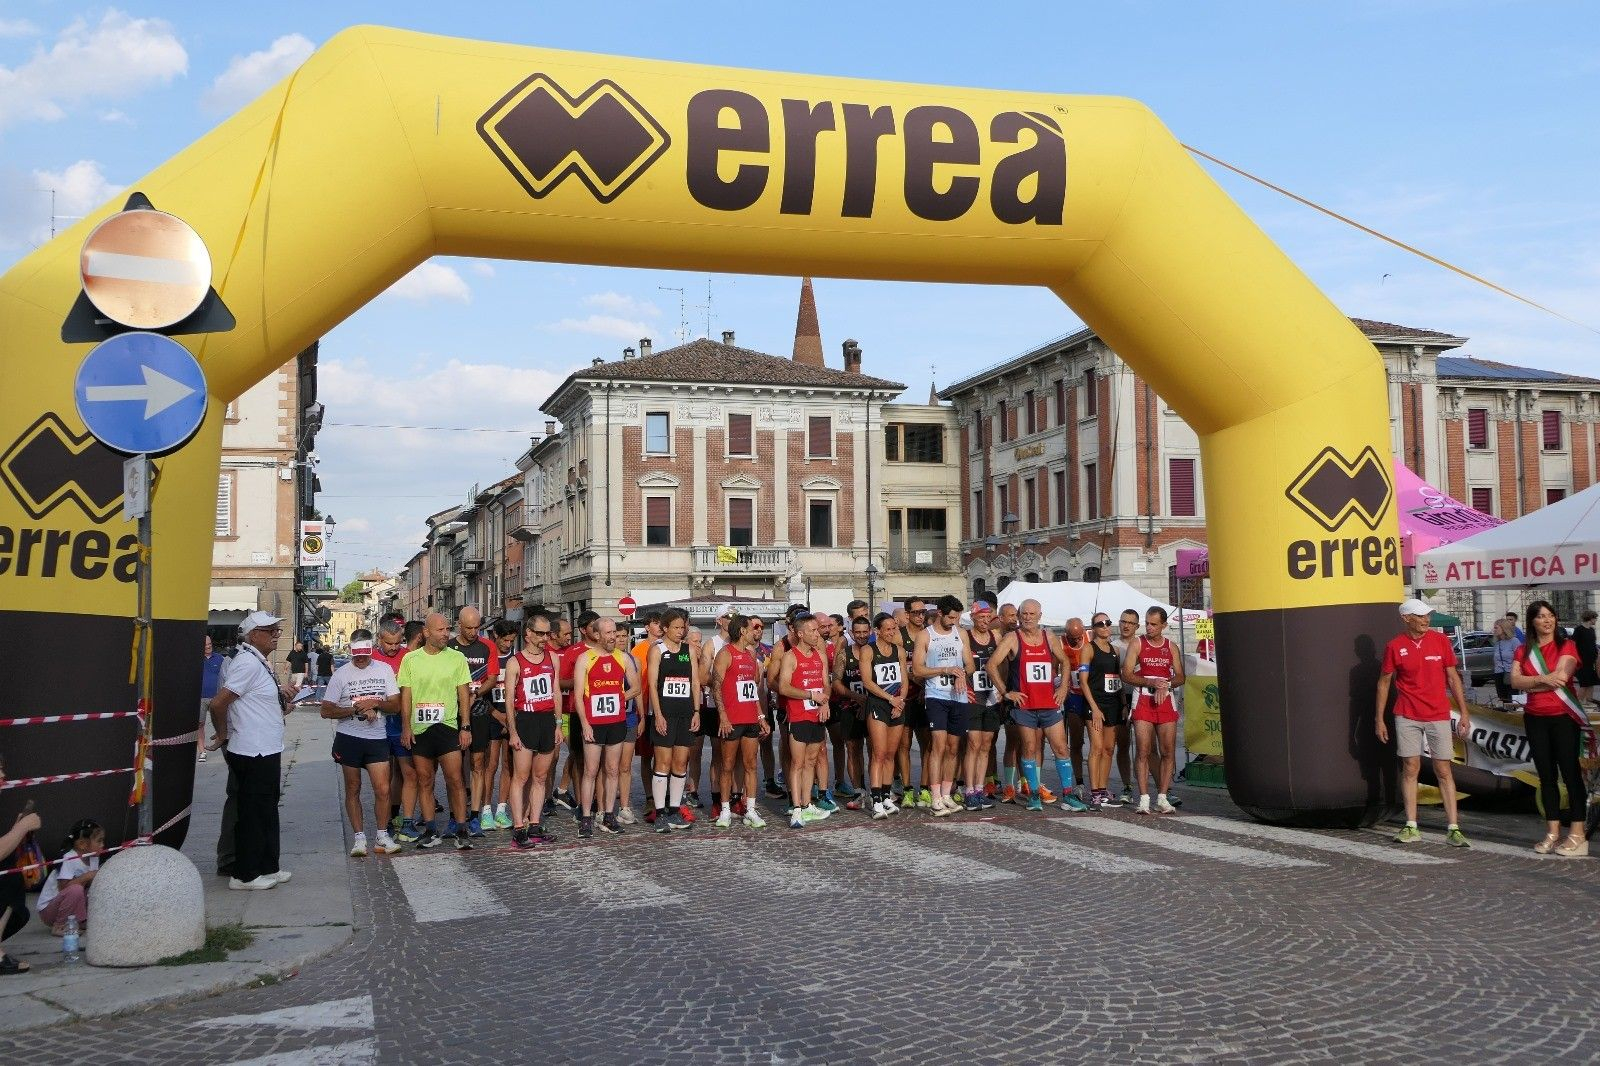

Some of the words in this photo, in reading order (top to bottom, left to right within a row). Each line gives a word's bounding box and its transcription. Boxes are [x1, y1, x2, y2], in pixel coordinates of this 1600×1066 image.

[1445, 555, 1566, 581] ATLETICA
[1574, 552, 1600, 575] PI
[880, 664, 897, 682] 23
[1032, 664, 1047, 681] 51
[530, 677, 548, 696] 40
[667, 682, 687, 695] 952
[742, 682, 755, 699] 42
[596, 696, 615, 714] 45
[418, 708, 440, 722] 962
[1471, 727, 1533, 763] CAST
